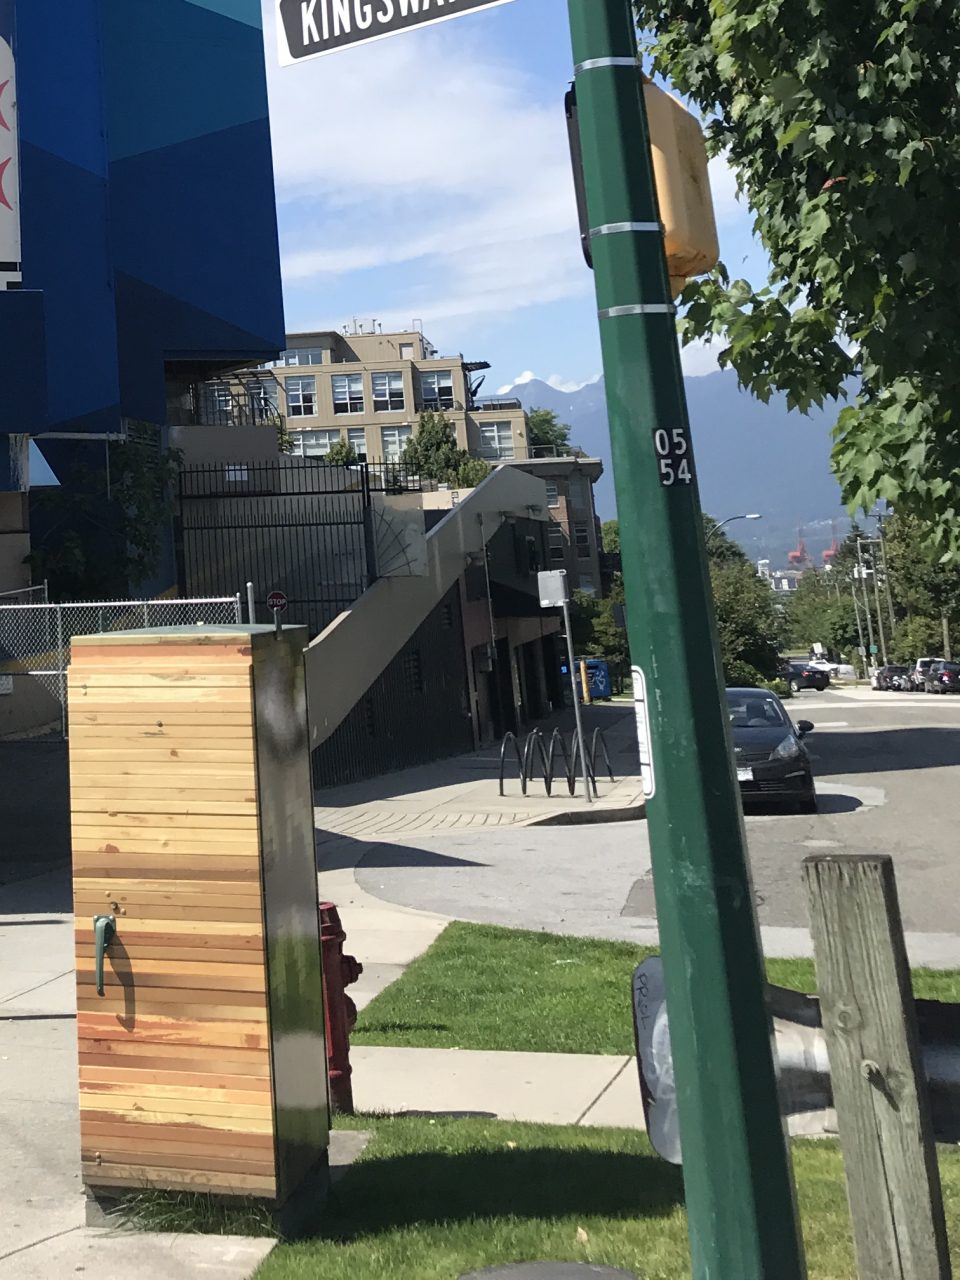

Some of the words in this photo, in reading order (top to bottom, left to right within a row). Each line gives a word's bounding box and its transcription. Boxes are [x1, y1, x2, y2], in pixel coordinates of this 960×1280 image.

[654, 428, 687, 456] 05
[660, 458, 692, 486] 54
[268, 598, 287, 606] STOP
